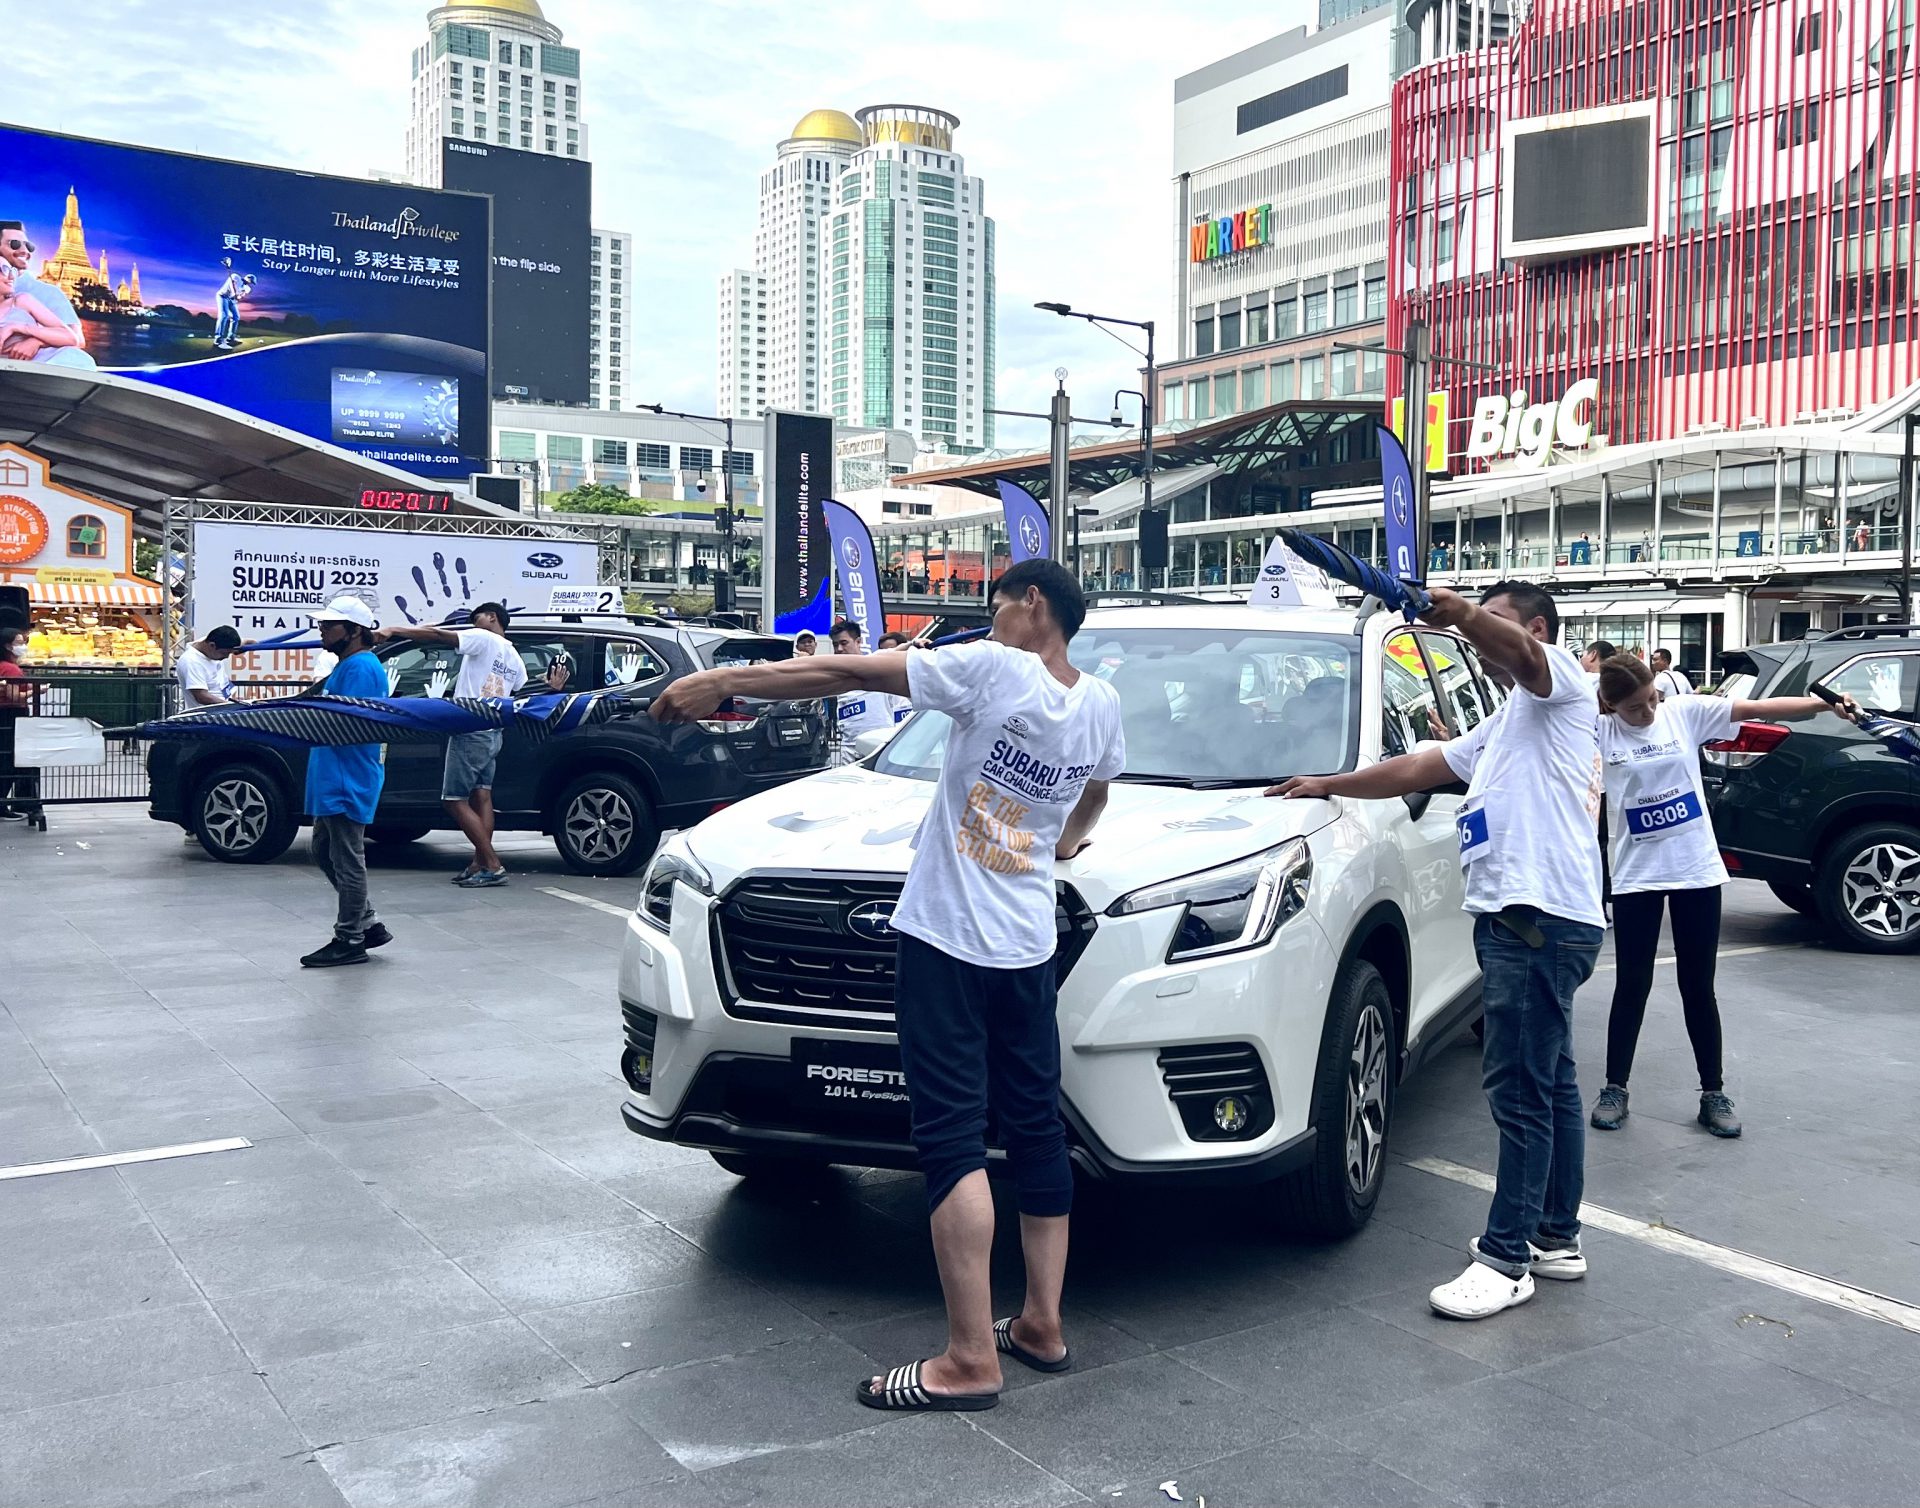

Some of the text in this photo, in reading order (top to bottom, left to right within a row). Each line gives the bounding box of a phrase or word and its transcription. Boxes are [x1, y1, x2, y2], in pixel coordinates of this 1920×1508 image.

[449, 143, 487, 157] SAMSUNG
[1194, 212, 1210, 224] THE
[1191, 203, 1273, 263] MARKET
[261, 258, 460, 289] Stay Longer with More Lifestyles
[500, 256, 518, 268] the
[520, 257, 537, 272] flip
[538, 260, 561, 274] side
[797, 452, 809, 599] www.thailandelite.com
[233, 566, 379, 591] SUBARU 2023
[521, 571, 568, 580] SUBARU
[232, 589, 323, 604] CAR CHALLENGE
[552, 591, 581, 600] SUBARU
[1270, 585, 1280, 599] 3
[596, 591, 613, 613] 2
[232, 615, 380, 631] THAILD
[625, 643, 637, 652] 11
[231, 649, 315, 671] BE THE
[387, 657, 400, 666] 07
[435, 660, 448, 670] 08
[554, 654, 567, 664] 10
[1001, 723, 1028, 740] SUBARU
[1631, 744, 1663, 756] SUBARU
[990, 739, 1063, 787] SUBARU
[982, 759, 1053, 800] CAR CHALLENGE
[967, 780, 1030, 829] BE THE
[1637, 787, 1680, 805] CHALLENGER
[1640, 801, 1689, 829] 0308
[960, 804, 1003, 845] LAST
